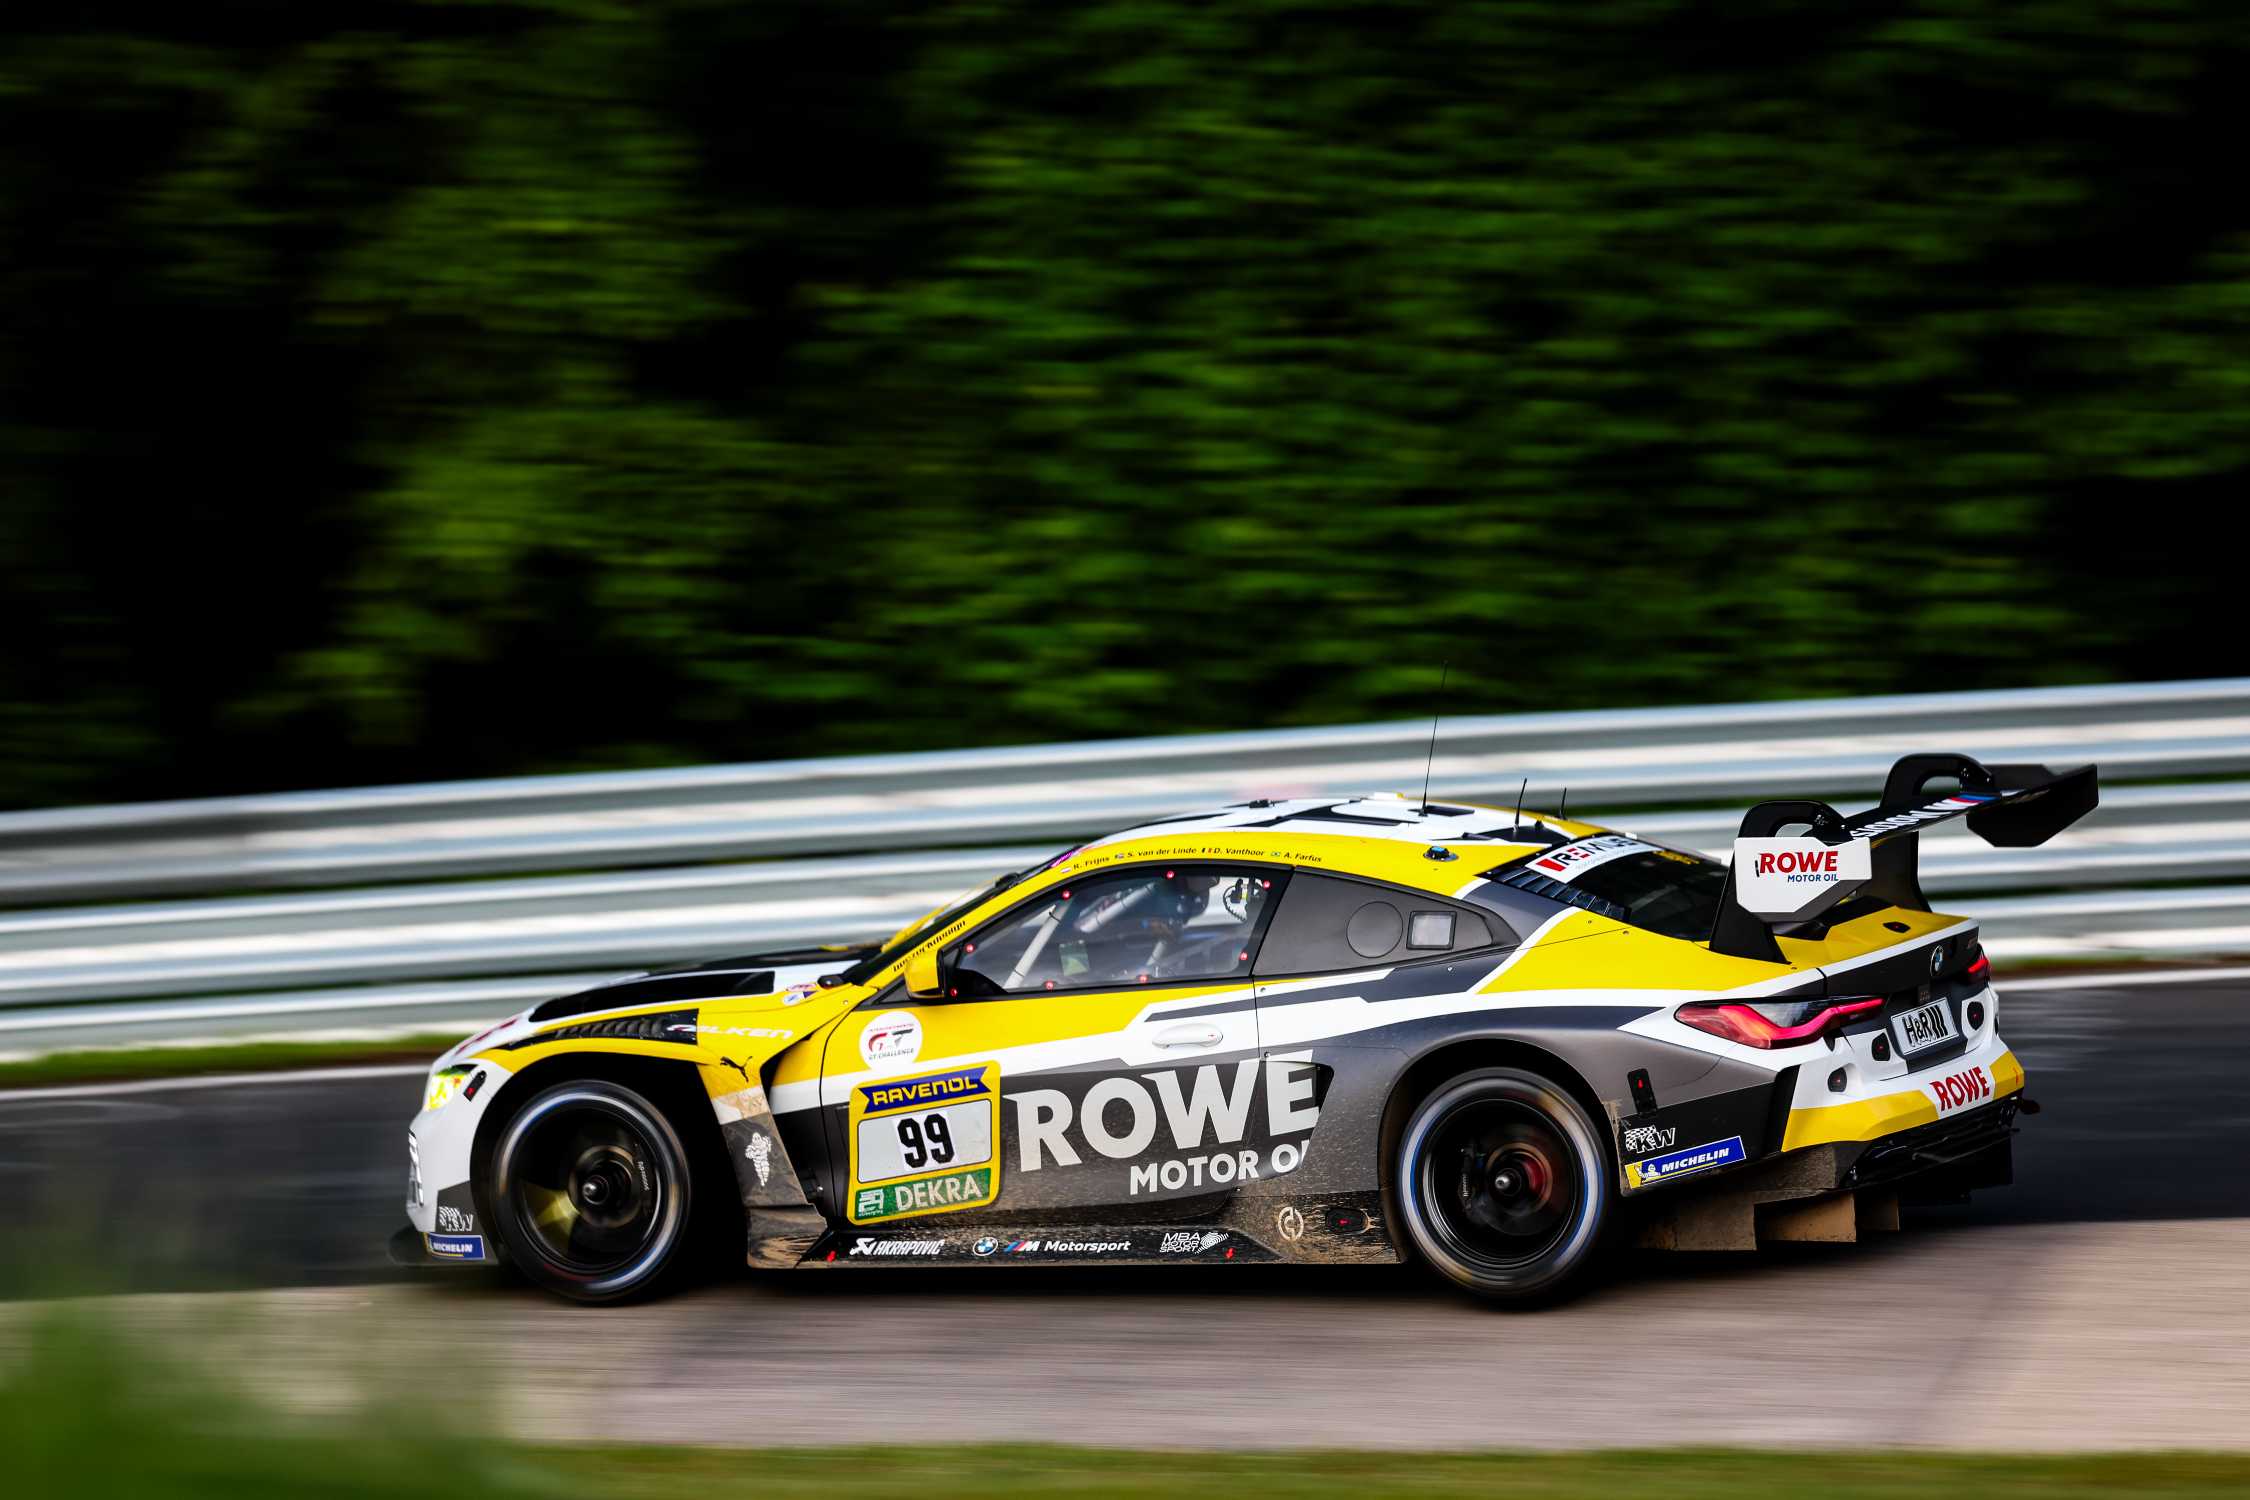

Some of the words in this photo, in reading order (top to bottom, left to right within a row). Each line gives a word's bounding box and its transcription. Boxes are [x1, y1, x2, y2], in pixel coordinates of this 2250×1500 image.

[1173, 847, 1197, 855] Linde
[1225, 847, 1265, 856] Vanthoor
[1295, 853, 1322, 862] Farfus
[1759, 851, 1838, 873] ROWE
[872, 1076, 978, 1106] RAVENOL
[1930, 1066, 1990, 1111] ROWE
[1002, 1049, 1320, 1172] ROWE
[897, 1113, 955, 1168] 99
[1661, 1148, 1729, 1172] MICHELIN
[1130, 1151, 1260, 1195] MOTOR
[895, 1174, 982, 1211] DEKRA
[1044, 1240, 1131, 1253] Motorsport
[1162, 1232, 1200, 1242] MBA
